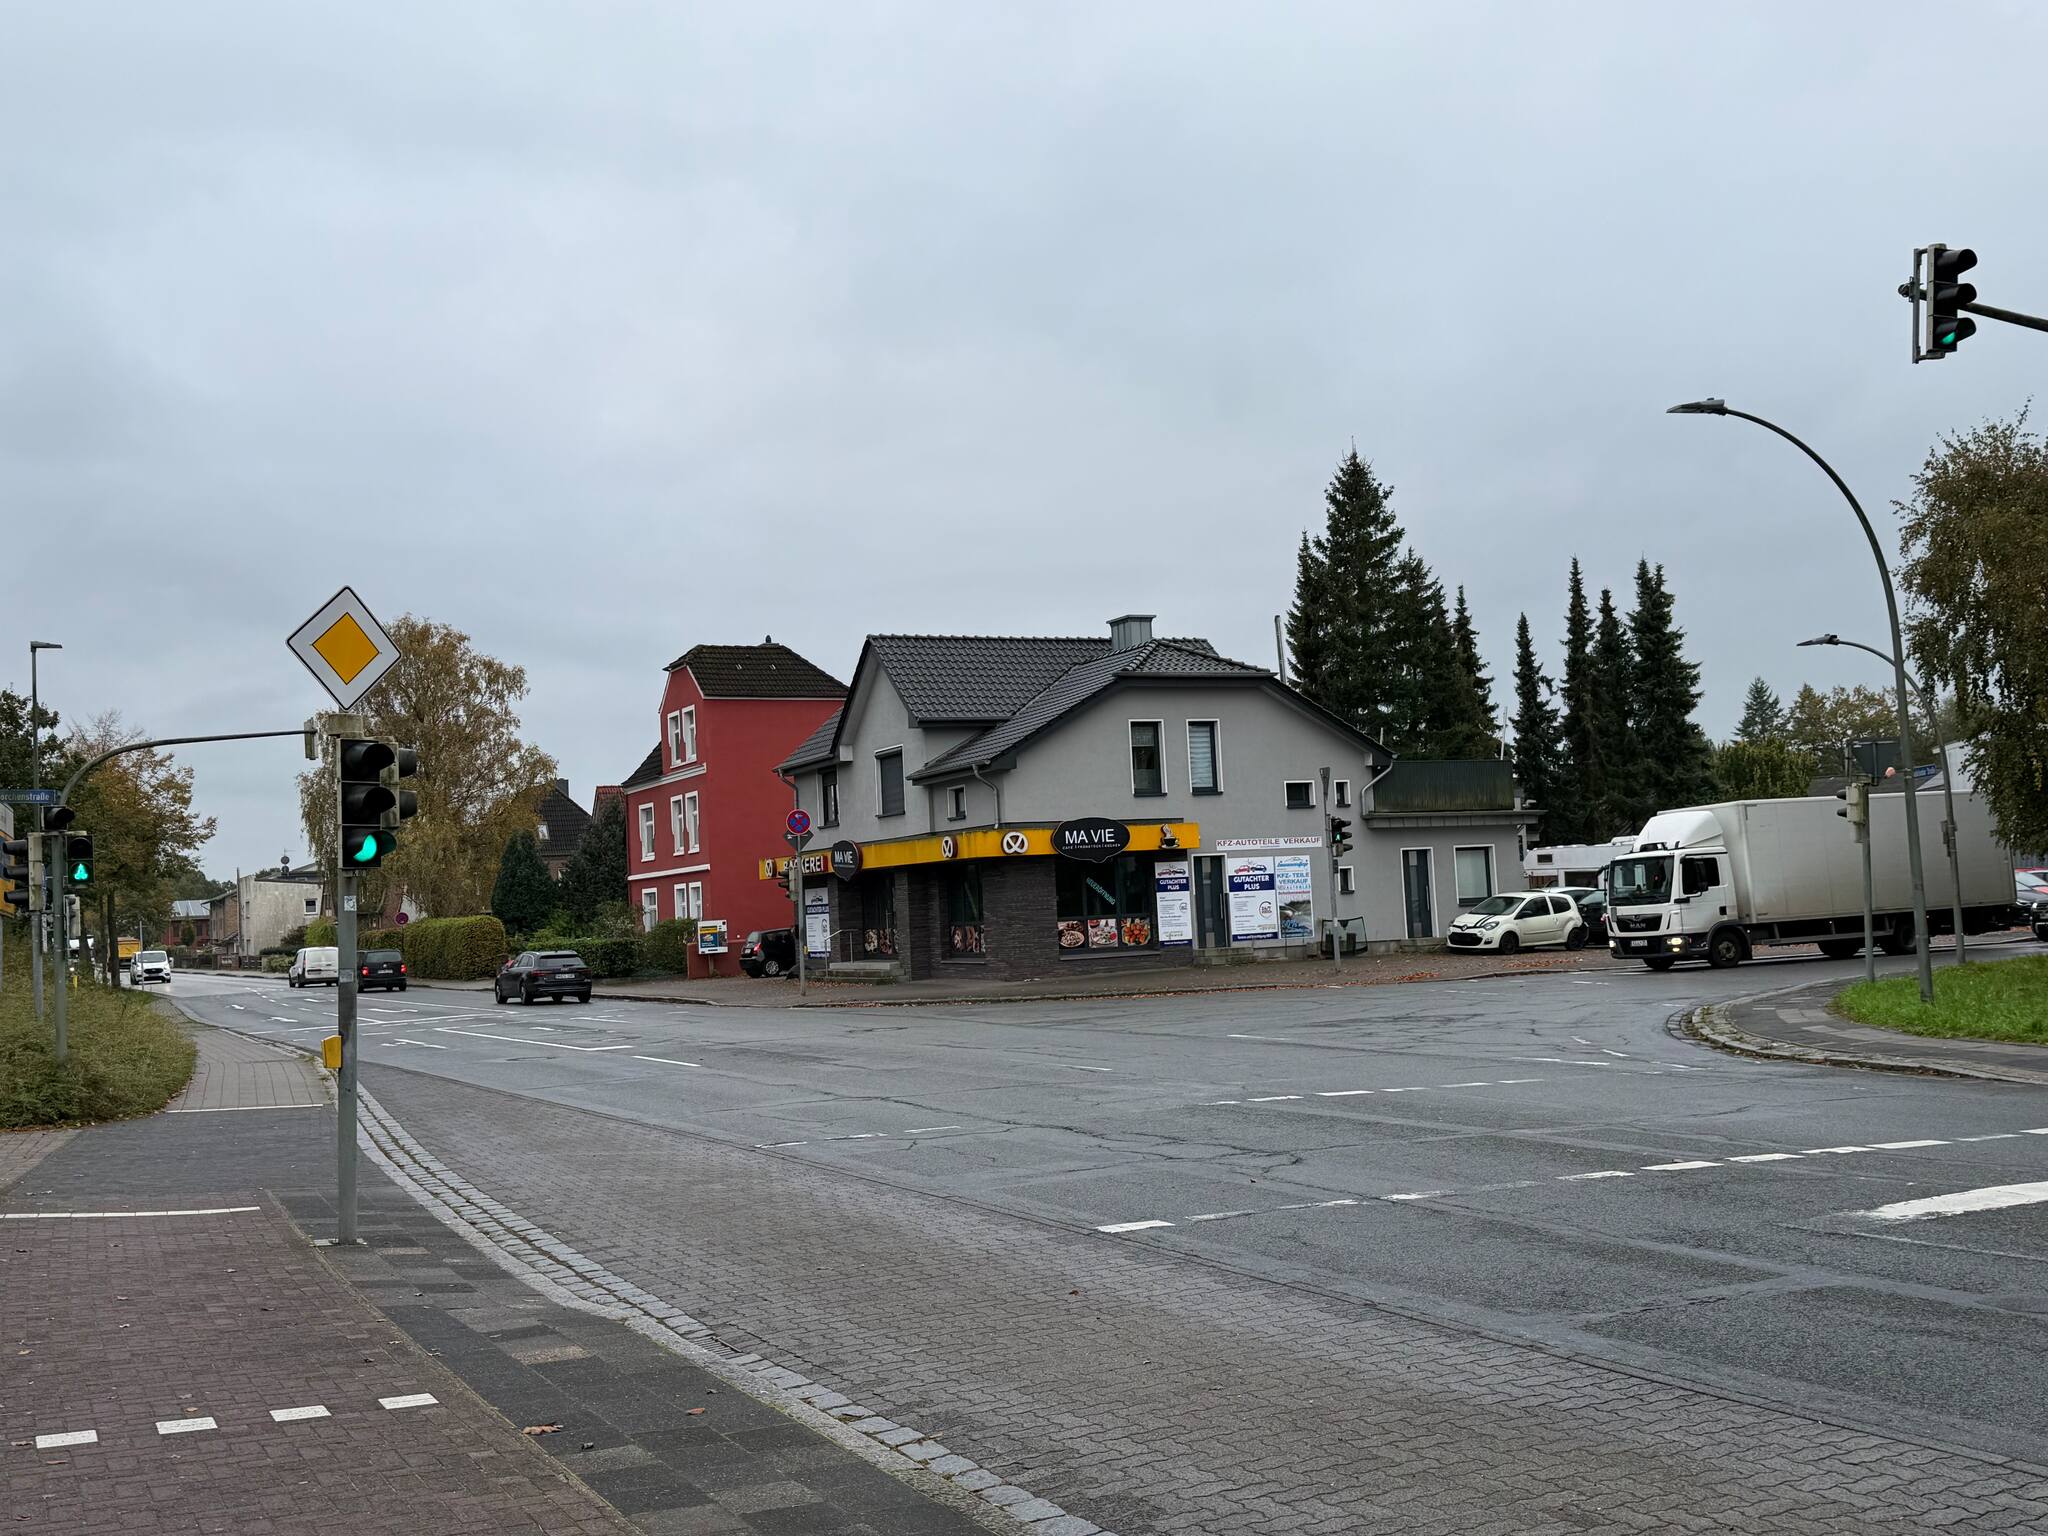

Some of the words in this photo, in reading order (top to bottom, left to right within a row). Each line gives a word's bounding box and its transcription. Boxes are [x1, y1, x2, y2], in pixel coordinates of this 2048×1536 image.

[1065, 829, 1089, 844] MA
[1090, 828, 1115, 843] VIE
[1217, 838, 1280, 847] KFZ-AUTOTEILE
[1283, 836, 1321, 844] VERKAUF
[834, 850, 844, 863] MA
[843, 850, 853, 864] VIE
[1233, 875, 1270, 883] GUTACHTER
